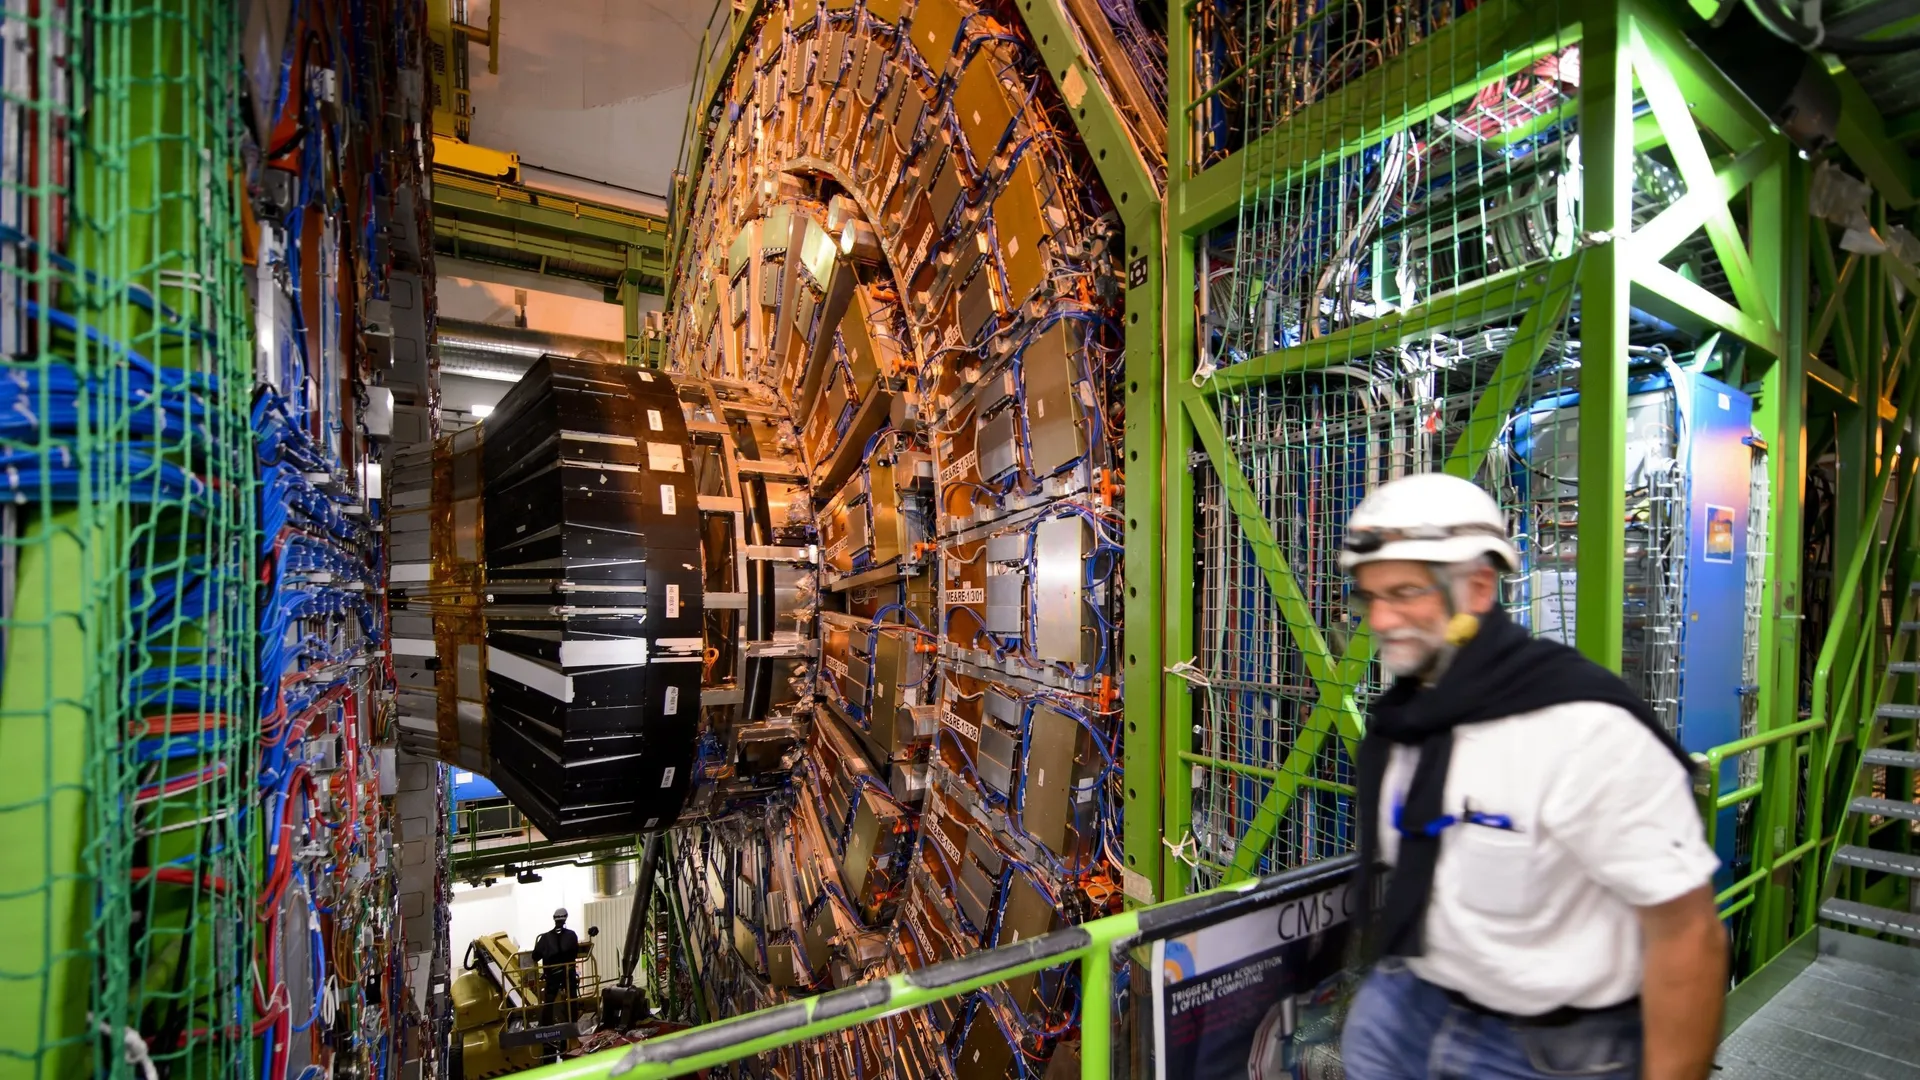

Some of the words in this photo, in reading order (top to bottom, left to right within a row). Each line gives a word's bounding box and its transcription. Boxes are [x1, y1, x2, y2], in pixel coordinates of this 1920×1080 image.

[1278, 891, 1334, 941] CMS
[1180, 990, 1215, 1012] OFFLINE
[1217, 971, 1264, 997] COMPUTING
[1211, 972, 1233, 988] DATA
[1234, 956, 1282, 980] ACQUISITION
